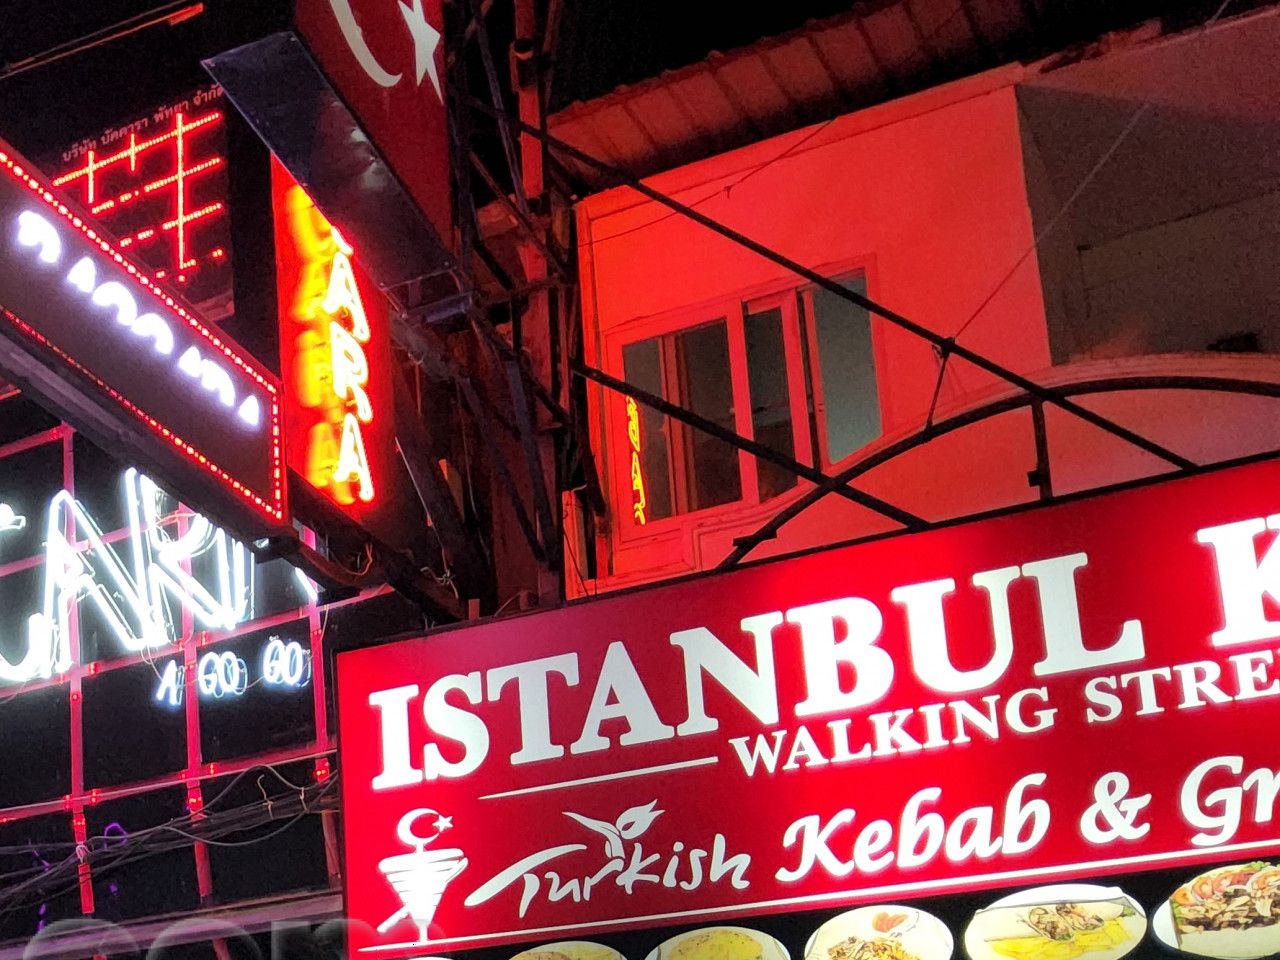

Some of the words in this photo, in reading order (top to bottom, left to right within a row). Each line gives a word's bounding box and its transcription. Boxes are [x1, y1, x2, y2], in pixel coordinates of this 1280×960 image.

[368, 551, 1146, 792] ISTANBUL
[728, 685, 1059, 777] WALKING
[464, 828, 751, 919] Turkish
[774, 772, 1051, 884] Kebab
[1079, 770, 1152, 845] &
